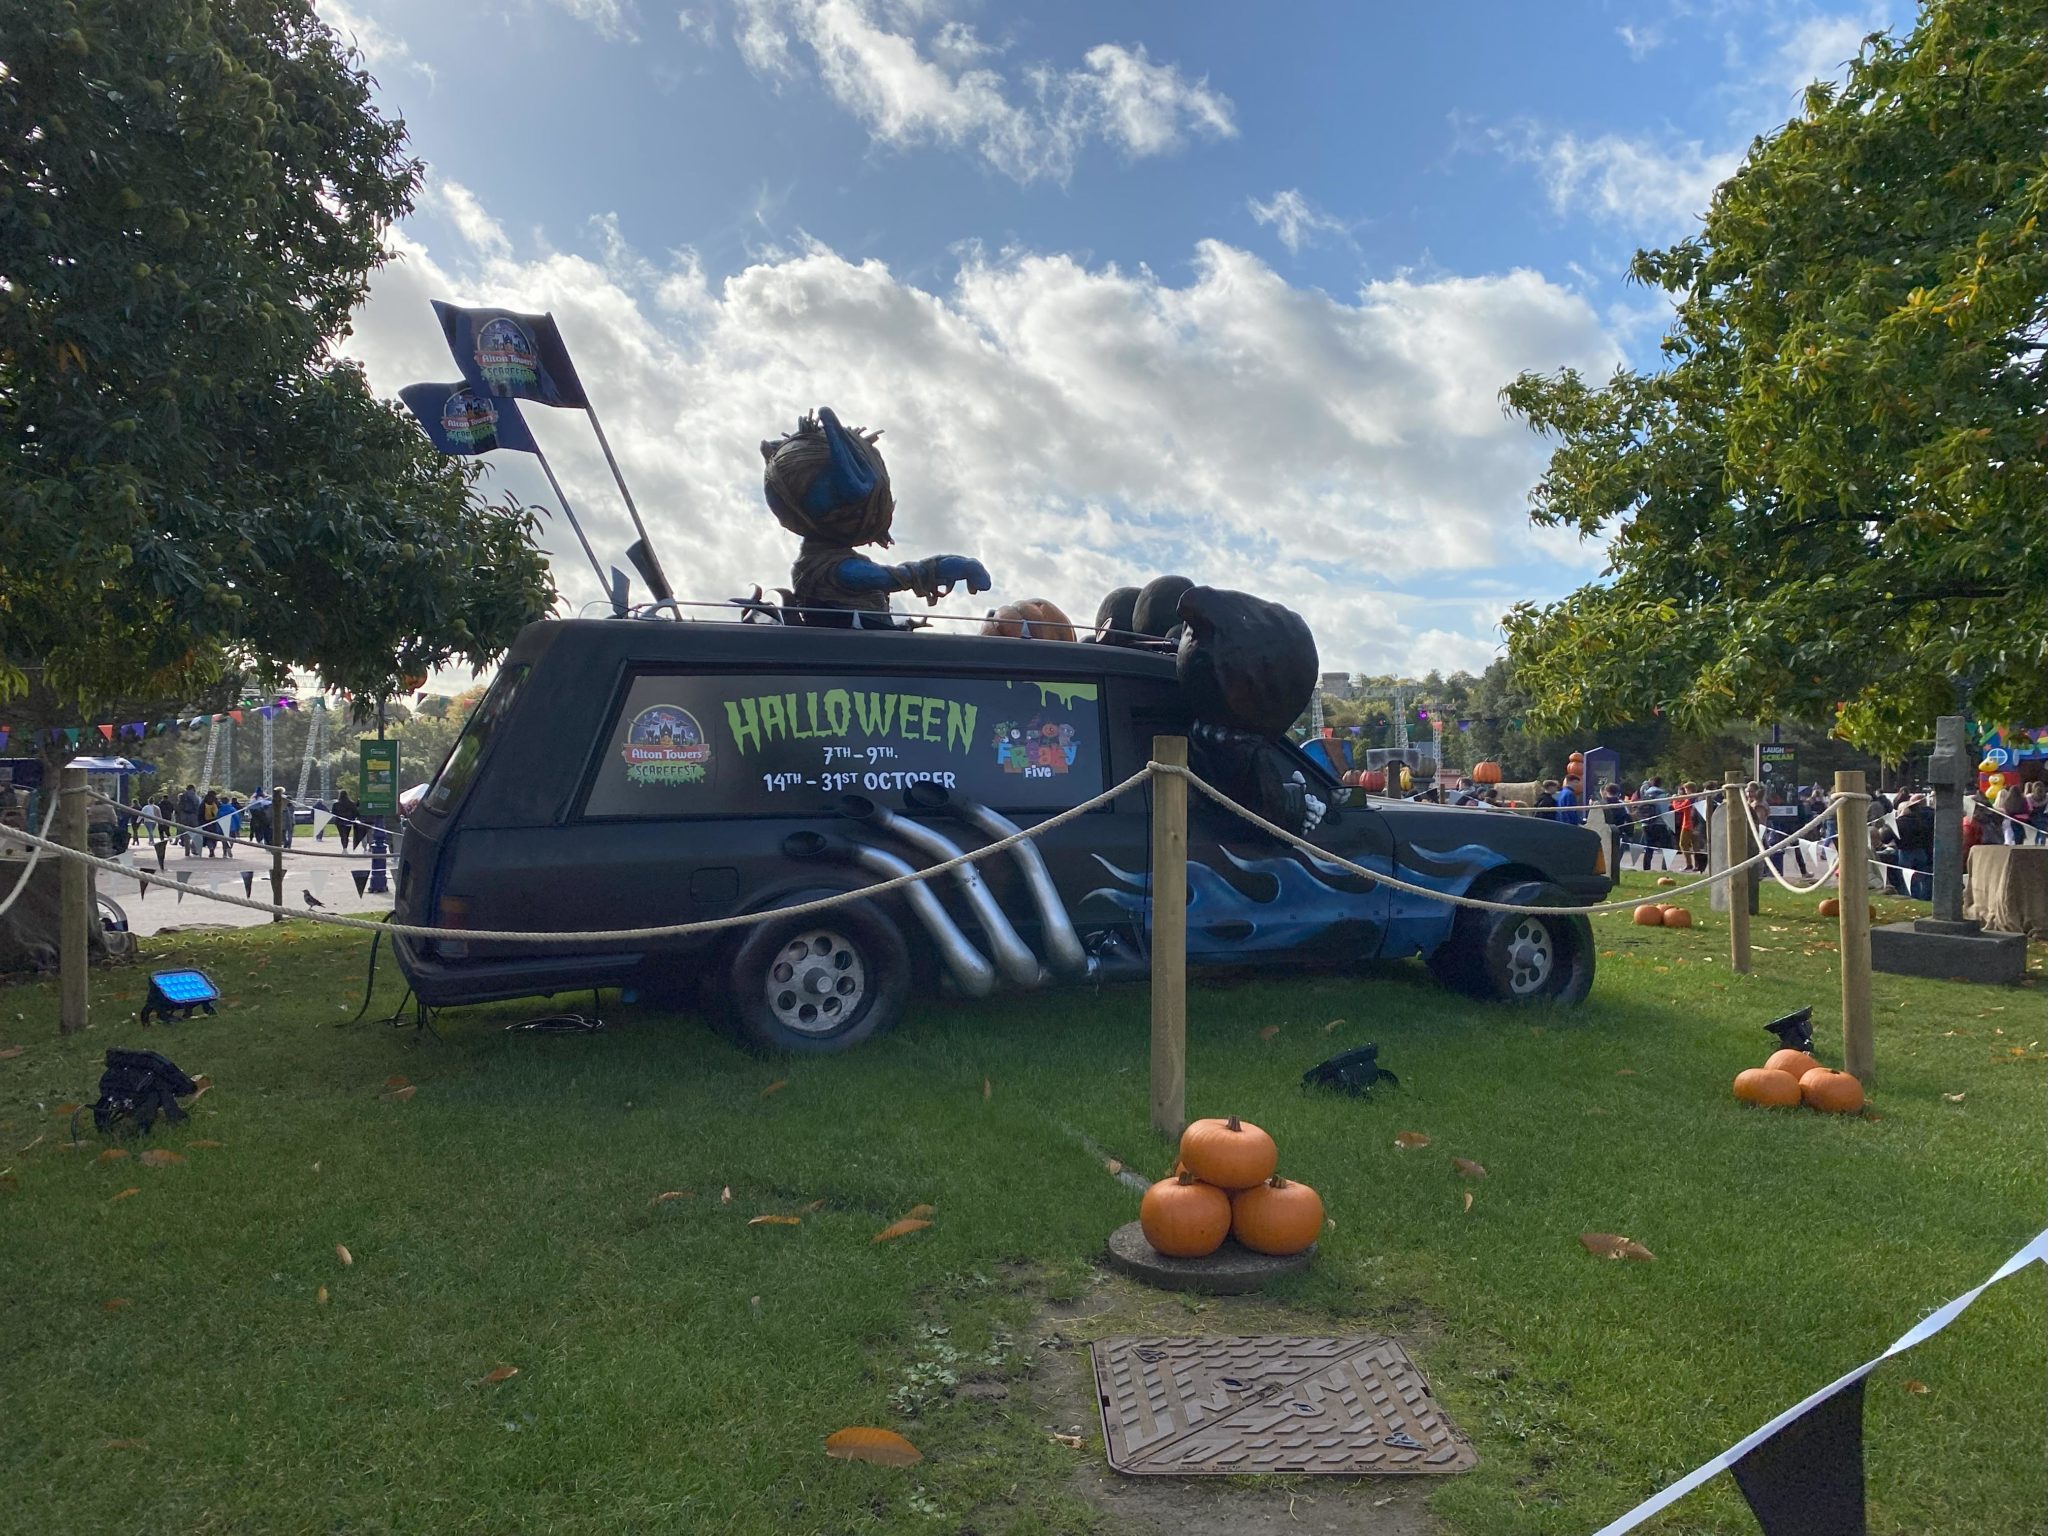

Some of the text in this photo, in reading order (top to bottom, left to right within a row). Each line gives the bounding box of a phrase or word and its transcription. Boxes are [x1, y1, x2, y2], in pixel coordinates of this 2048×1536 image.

[723, 688, 978, 756] HALLOWEEN
[631, 748, 703, 759] Alton Towers
[635, 764, 697, 776] SCAREFEST
[763, 773, 801, 792] 14TH
[821, 772, 859, 791] 31ST
